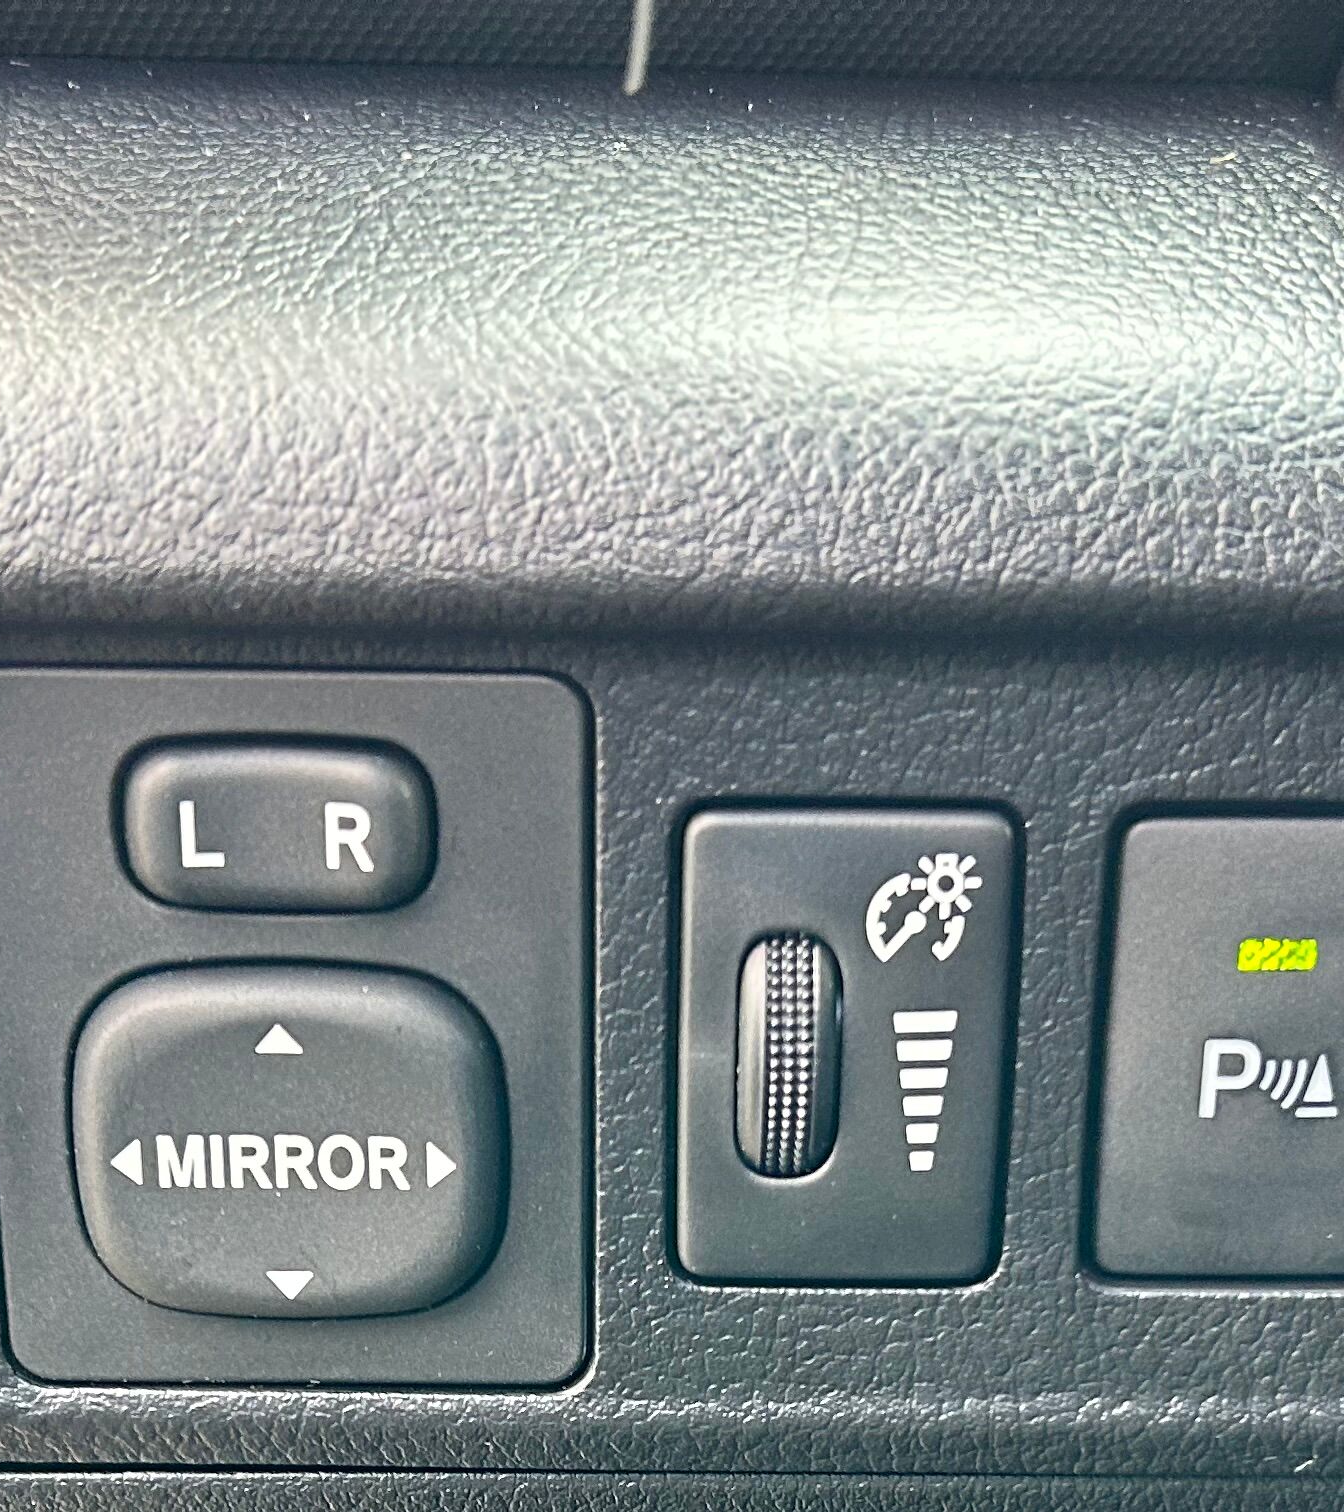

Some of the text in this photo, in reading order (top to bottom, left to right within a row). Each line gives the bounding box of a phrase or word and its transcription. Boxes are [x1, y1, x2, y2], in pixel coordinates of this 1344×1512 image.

[178, 800, 375, 873] L R
[1198, 1038, 1261, 1119] P
[156, 1134, 411, 1191] MIRROR
